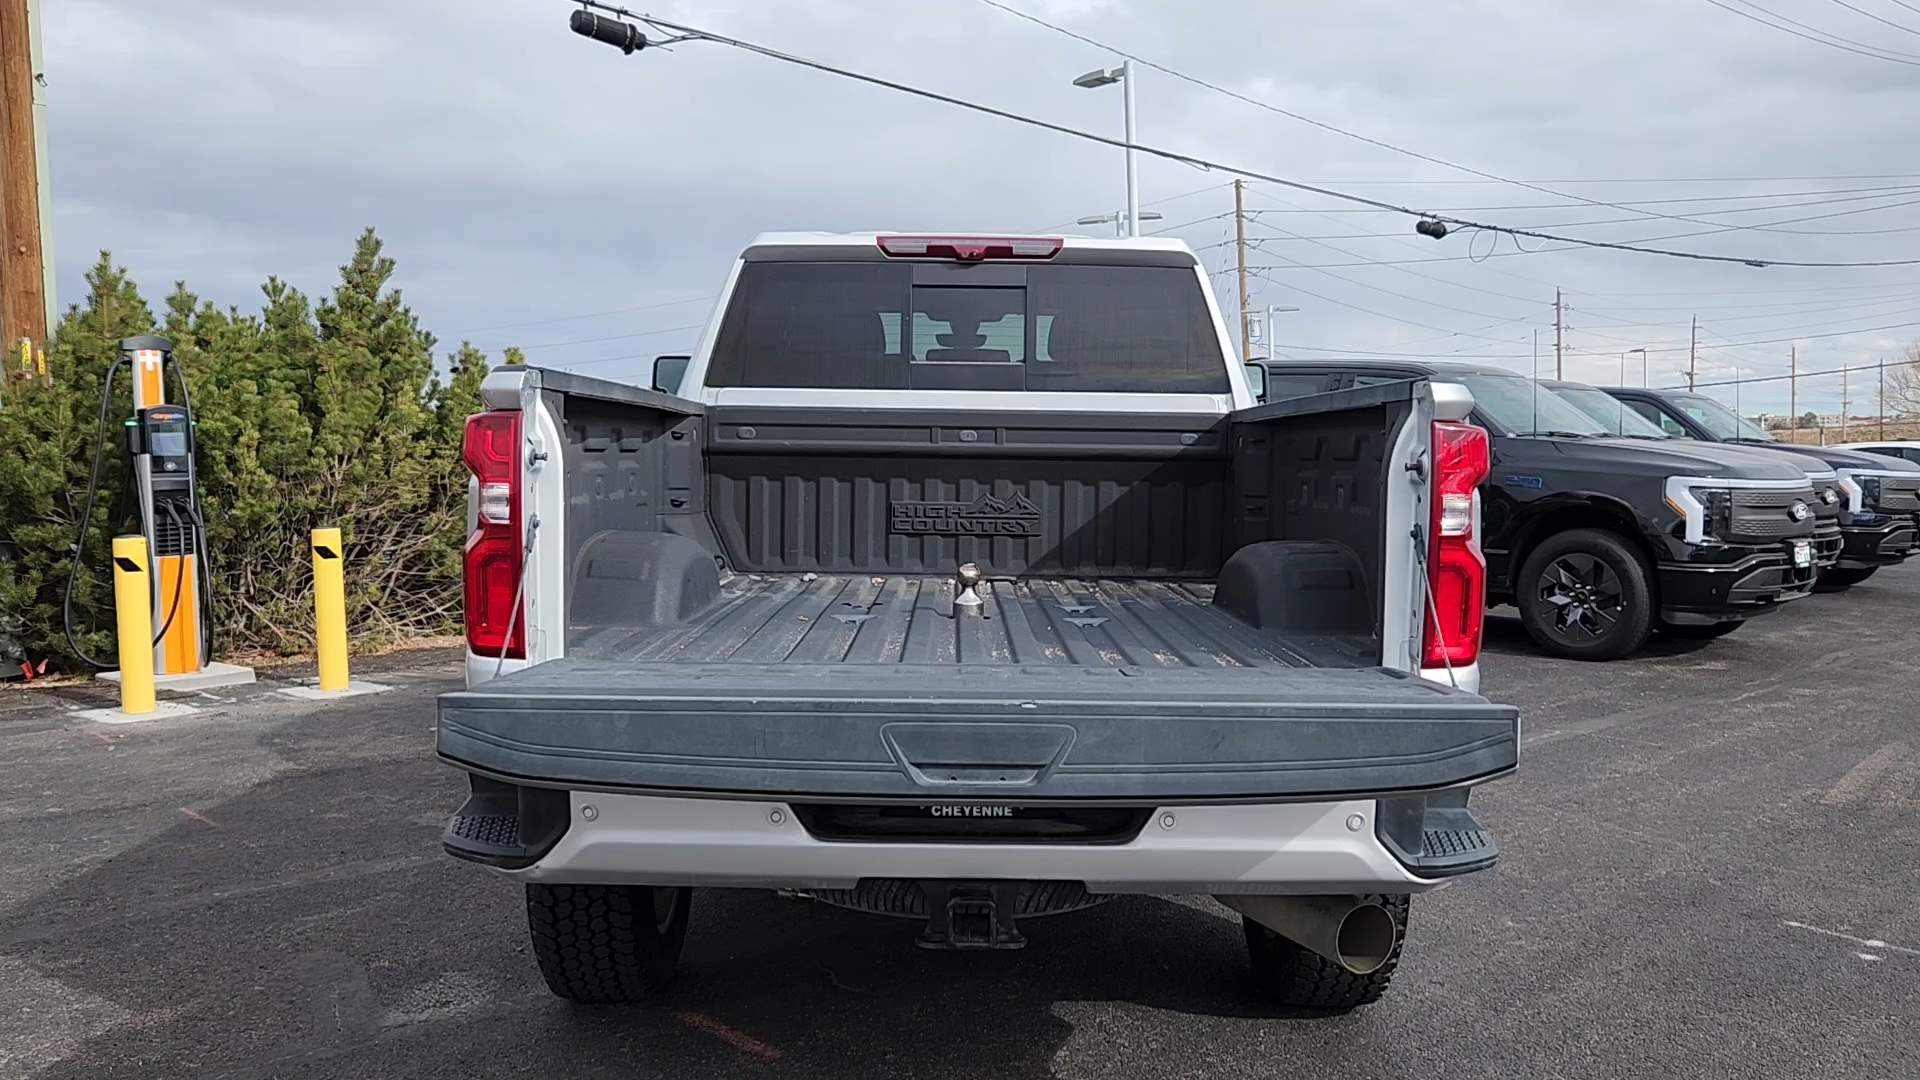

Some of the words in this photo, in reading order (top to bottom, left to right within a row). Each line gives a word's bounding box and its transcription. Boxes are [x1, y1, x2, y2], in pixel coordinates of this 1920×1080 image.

[893, 504, 966, 518] HIGH
[893, 518, 1039, 533] COUNTRY
[931, 805, 1013, 816] CHEYENNE
